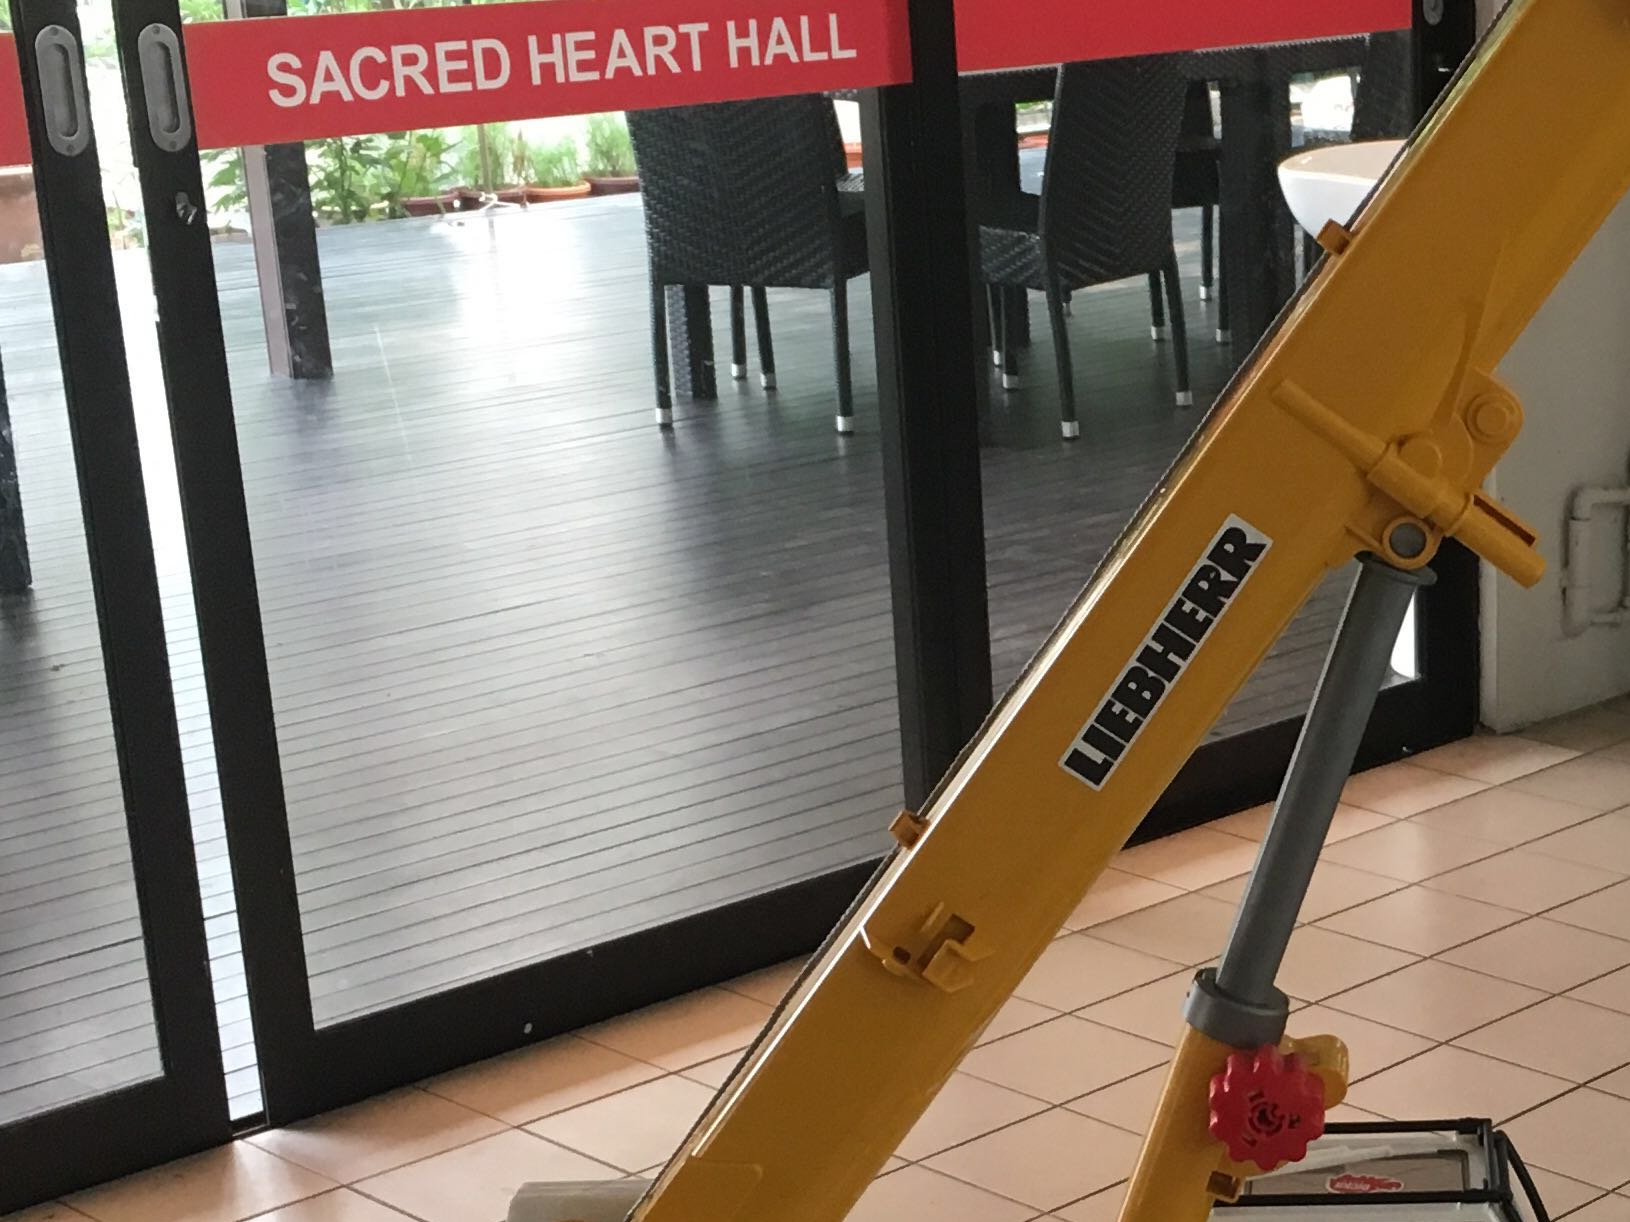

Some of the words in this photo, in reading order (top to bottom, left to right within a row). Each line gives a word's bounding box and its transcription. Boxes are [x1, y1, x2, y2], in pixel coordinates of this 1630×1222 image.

[266, 38, 511, 108] SACRED
[527, 22, 709, 86] HEART
[727, 12, 857, 68] HALL
[1064, 527, 1268, 786] LIEBHERR
